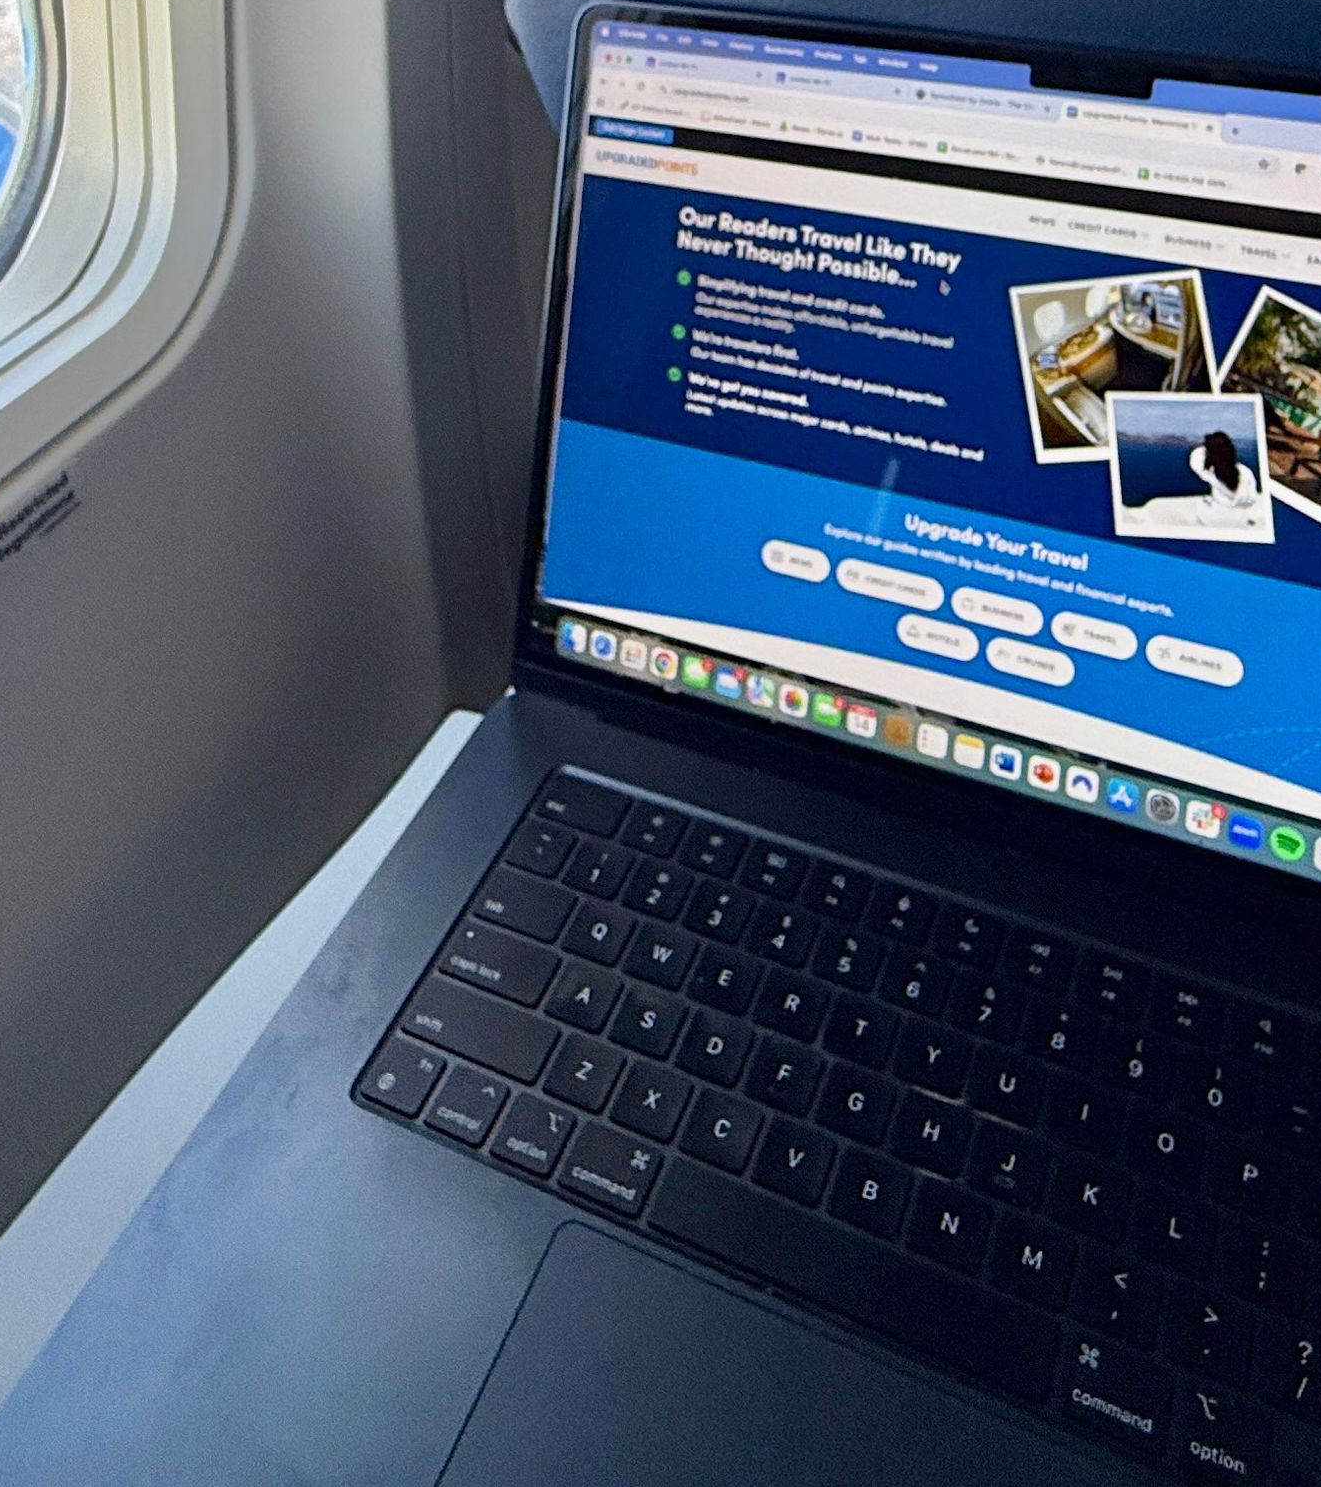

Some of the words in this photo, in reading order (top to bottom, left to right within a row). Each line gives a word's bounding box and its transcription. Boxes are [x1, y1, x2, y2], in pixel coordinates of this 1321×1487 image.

[679, 205, 717, 230] Our
[718, 212, 797, 243] Readers
[800, 224, 862, 254] Travel
[865, 235, 907, 262] Like
[909, 241, 962, 274] They
[677, 230, 733, 256] Never
[734, 238, 815, 272] Thought
[818, 252, 918, 289] Possible...
[905, 513, 984, 548] Upgrade
[985, 531, 1028, 557] Your
[1030, 541, 1088, 571] Travel
[590, 868, 600, 883] 1
[646, 888, 662, 905] 2
[707, 909, 723, 926] 3
[591, 922, 608, 941] Q
[771, 934, 786, 949] 4
[652, 944, 673, 963] W
[836, 956, 851, 973] 5
[717, 969, 733, 987] E
[575, 987, 591, 1005] A
[906, 981, 920, 998] 6
[784, 993, 801, 1012] R
[640, 1010, 657, 1029] S
[978, 1006, 992, 1022] 7
[855, 1019, 868, 1036] T
[706, 1036, 724, 1055] D
[1050, 1032, 1066, 1050] 8
[928, 1046, 942, 1064] Y
[574, 1060, 594, 1081] Z
[776, 1064, 792, 1081] F
[1128, 1059, 1144, 1078] 9
[999, 1073, 1017, 1093] U
[642, 1089, 662, 1110] X
[847, 1092, 865, 1112] G
[714, 1119, 732, 1138] C
[922, 1120, 941, 1142] H
[788, 1148, 805, 1168] V
[1001, 1154, 1016, 1172] J
[1242, 1163, 1259, 1181] P
[861, 1179, 879, 1201] B
[1082, 1183, 1099, 1205] K
[940, 1212, 960, 1235] N
[1168, 1217, 1182, 1240] L
[1021, 1246, 1044, 1271] M
[1071, 1388, 1153, 1433] command
[1189, 1440, 1246, 1475] option
